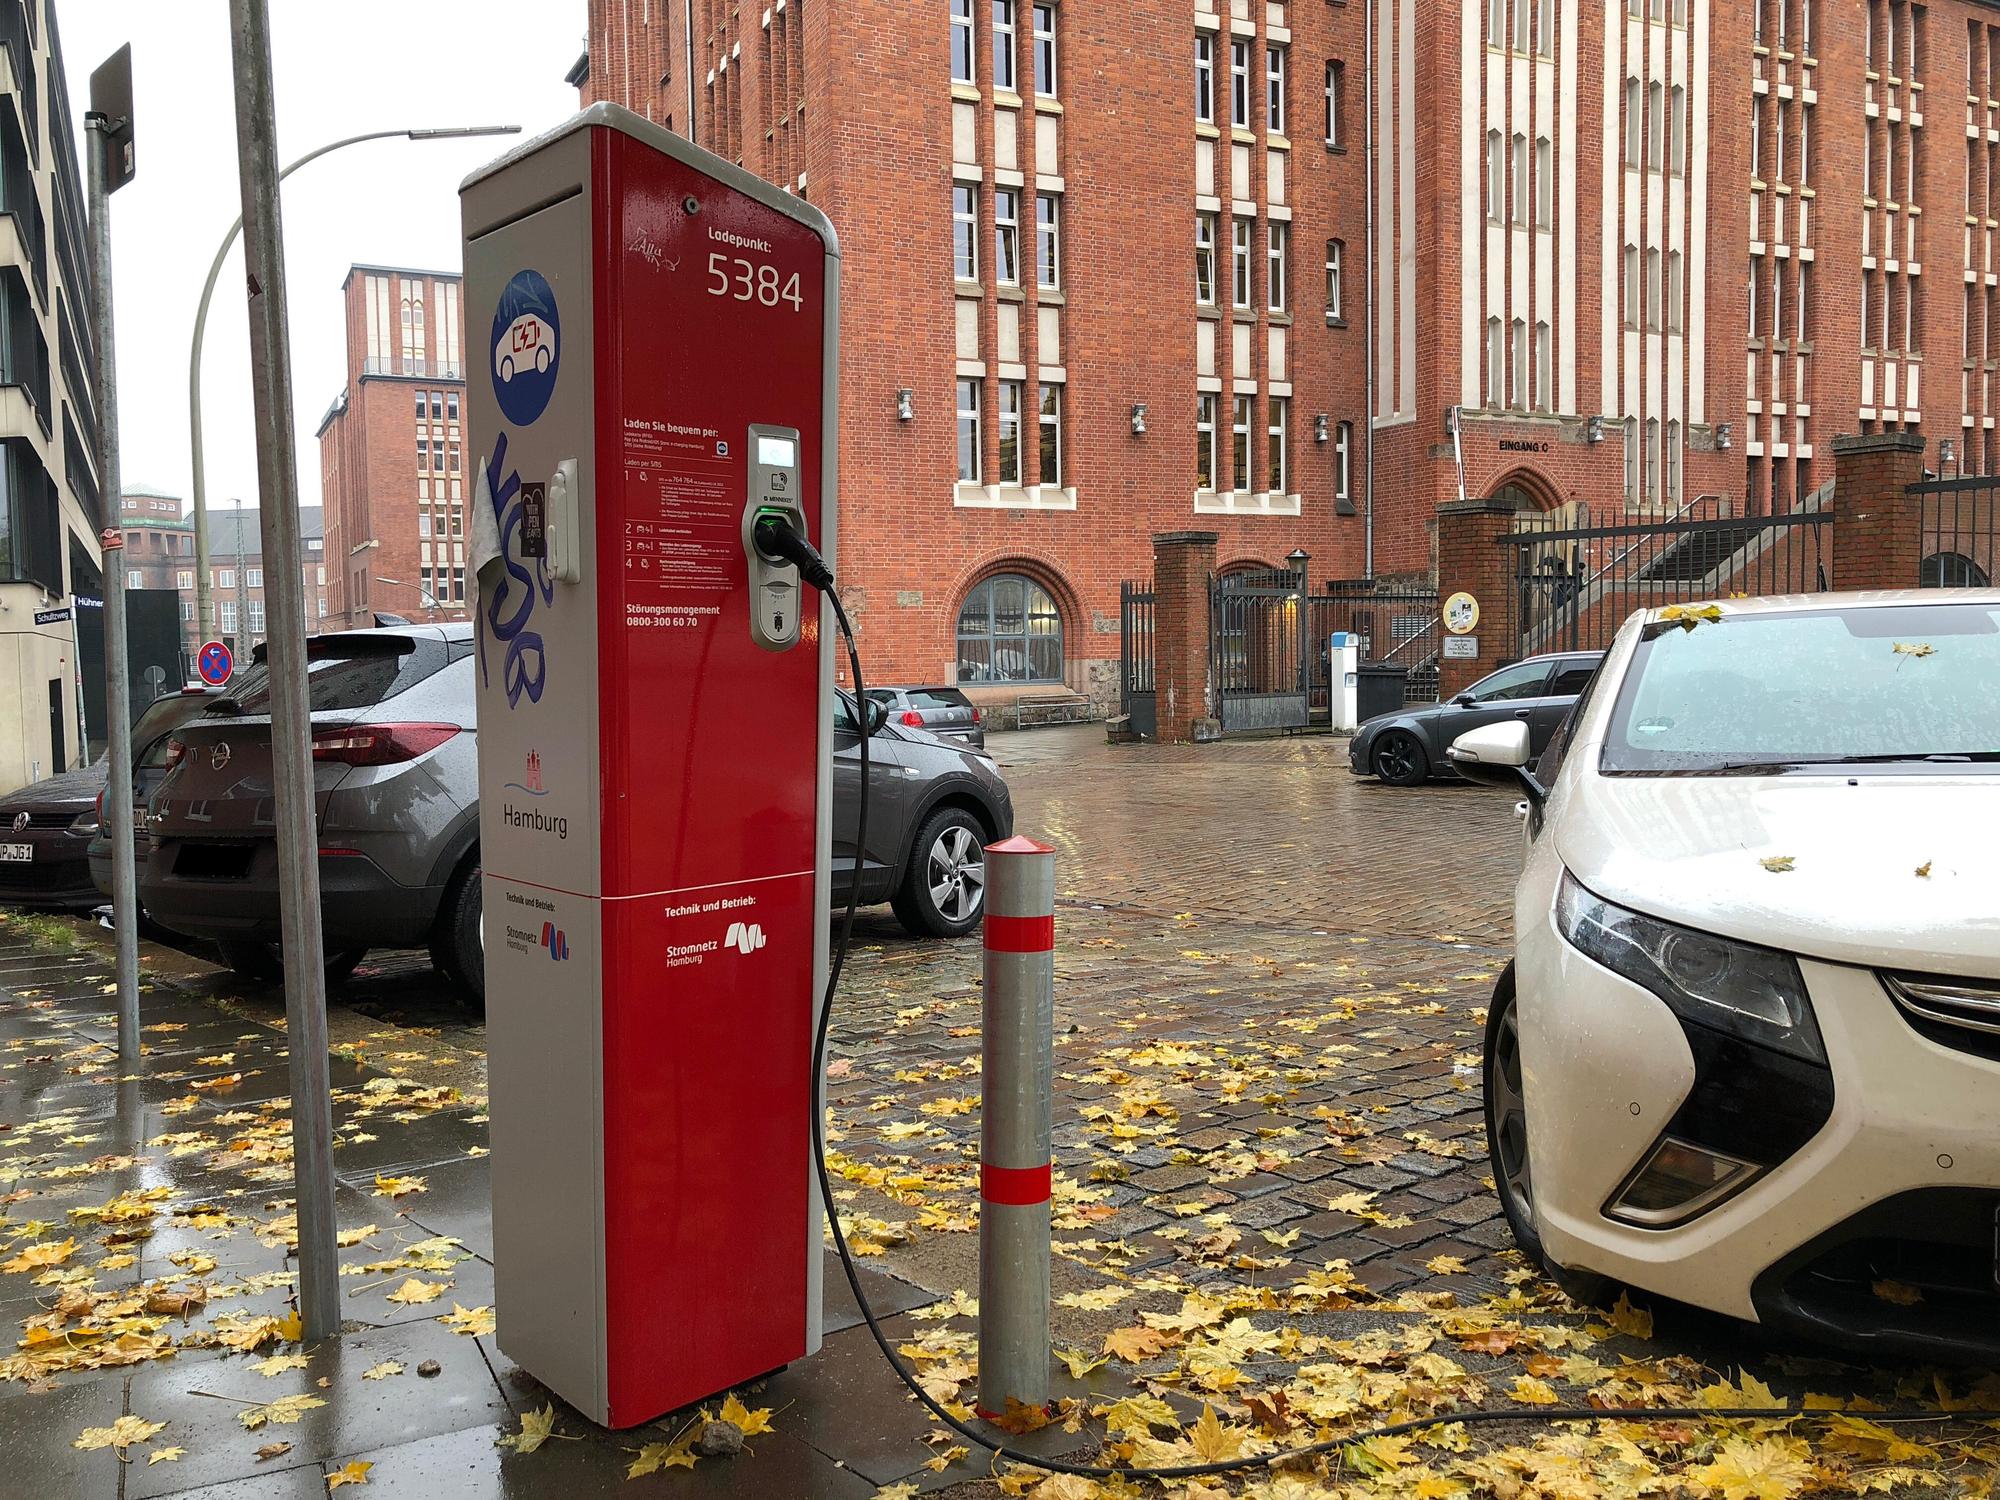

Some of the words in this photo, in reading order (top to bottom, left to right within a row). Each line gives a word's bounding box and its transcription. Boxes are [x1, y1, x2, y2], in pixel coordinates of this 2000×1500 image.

[708, 226, 772, 253] Ladepunkt:
[707, 252, 804, 312] 5384
[624, 418, 651, 430] Laden
[652, 421, 666, 431] Sie
[667, 423, 701, 435] bequem
[702, 428, 719, 438] per:
[1499, 440, 1540, 452] EINGANG
[1541, 442, 1549, 453] C
[624, 458, 640, 467] Laden
[640, 460, 650, 468] per
[624, 470, 629, 480] 1
[625, 523, 632, 534] 2
[625, 540, 632, 551] 3
[625, 558, 633, 569] 4
[626, 603, 720, 616] Störungsmanagement
[37, 611, 69, 623] Schultzweg
[626, 616, 671, 627] 0800-300
[672, 617, 685, 627] 60
[686, 617, 698, 627] 70
[503, 803, 568, 840] Hamburg
[506, 892, 525, 905] Technik
[525, 897, 535, 907] und
[535, 898, 556, 912] Betrieb:
[665, 903, 701, 918] Technik
[702, 900, 720, 912] und
[721, 895, 757, 909] Betrieb:
[506, 925, 537, 944] Stromnetz
[666, 940, 718, 958] Stromnetz
[666, 954, 703, 968] Hamburg
